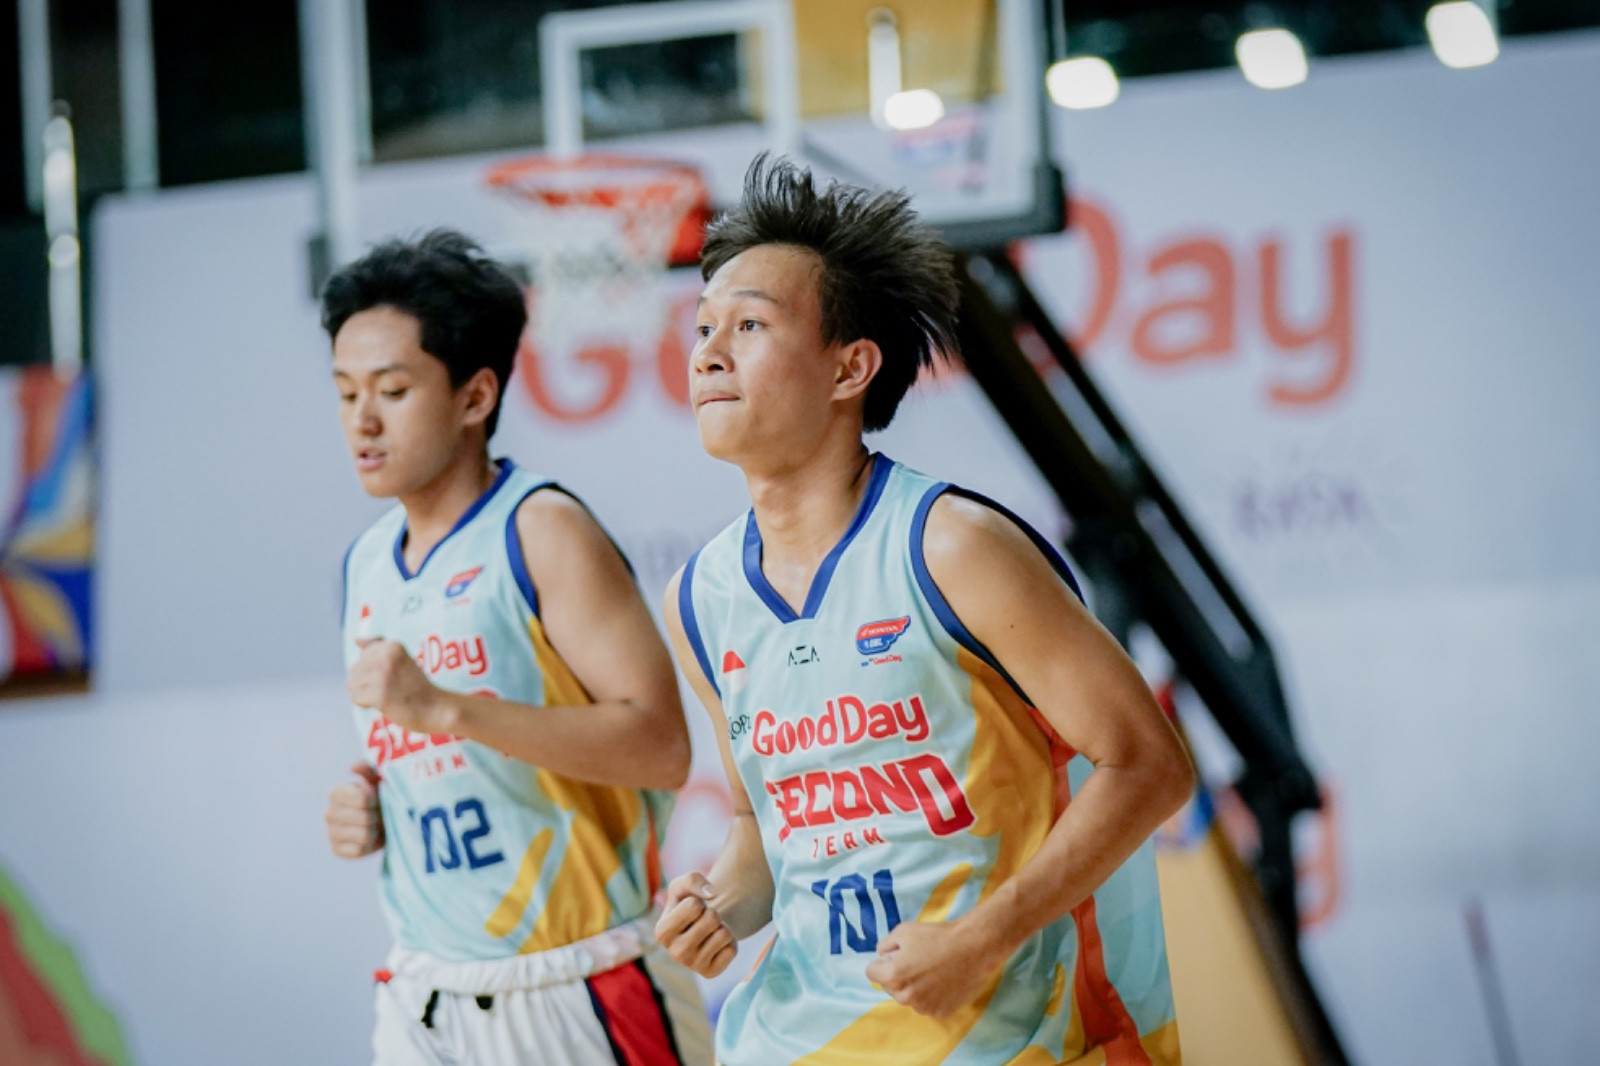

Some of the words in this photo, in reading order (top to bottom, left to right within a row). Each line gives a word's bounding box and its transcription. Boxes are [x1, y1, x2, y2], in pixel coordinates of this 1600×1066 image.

[753, 696, 929, 757] GoodDay
[407, 797, 505, 874] 102
[811, 868, 902, 956] 101
